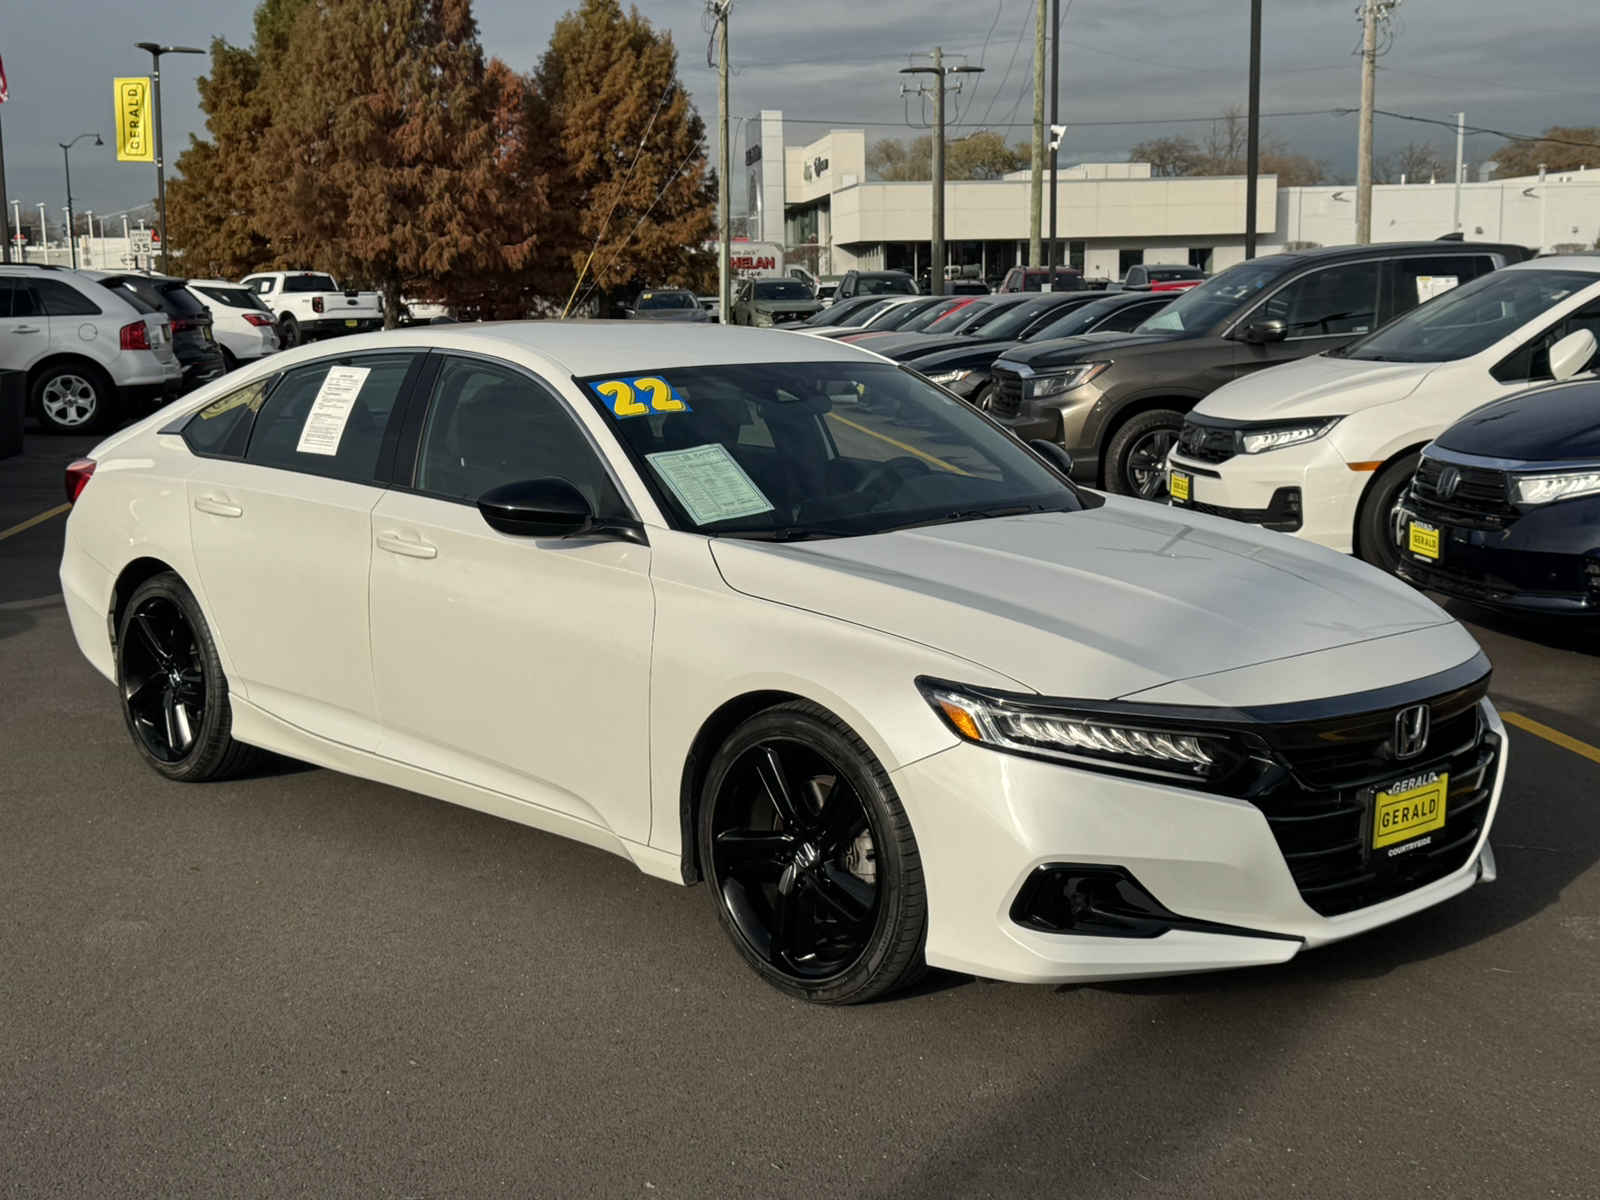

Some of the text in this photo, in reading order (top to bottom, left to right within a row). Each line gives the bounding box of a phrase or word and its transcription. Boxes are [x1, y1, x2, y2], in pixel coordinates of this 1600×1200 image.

[127, 88, 140, 150] GERALD
[133, 243, 150, 253] 35
[729, 256, 776, 270] HELAN
[596, 376, 686, 417] 22
[1413, 534, 1437, 549] GERALD
[1392, 771, 1440, 795] GERALD
[1381, 798, 1436, 829] GERALD
[1387, 836, 1432, 858] COUNTRYSIDE
